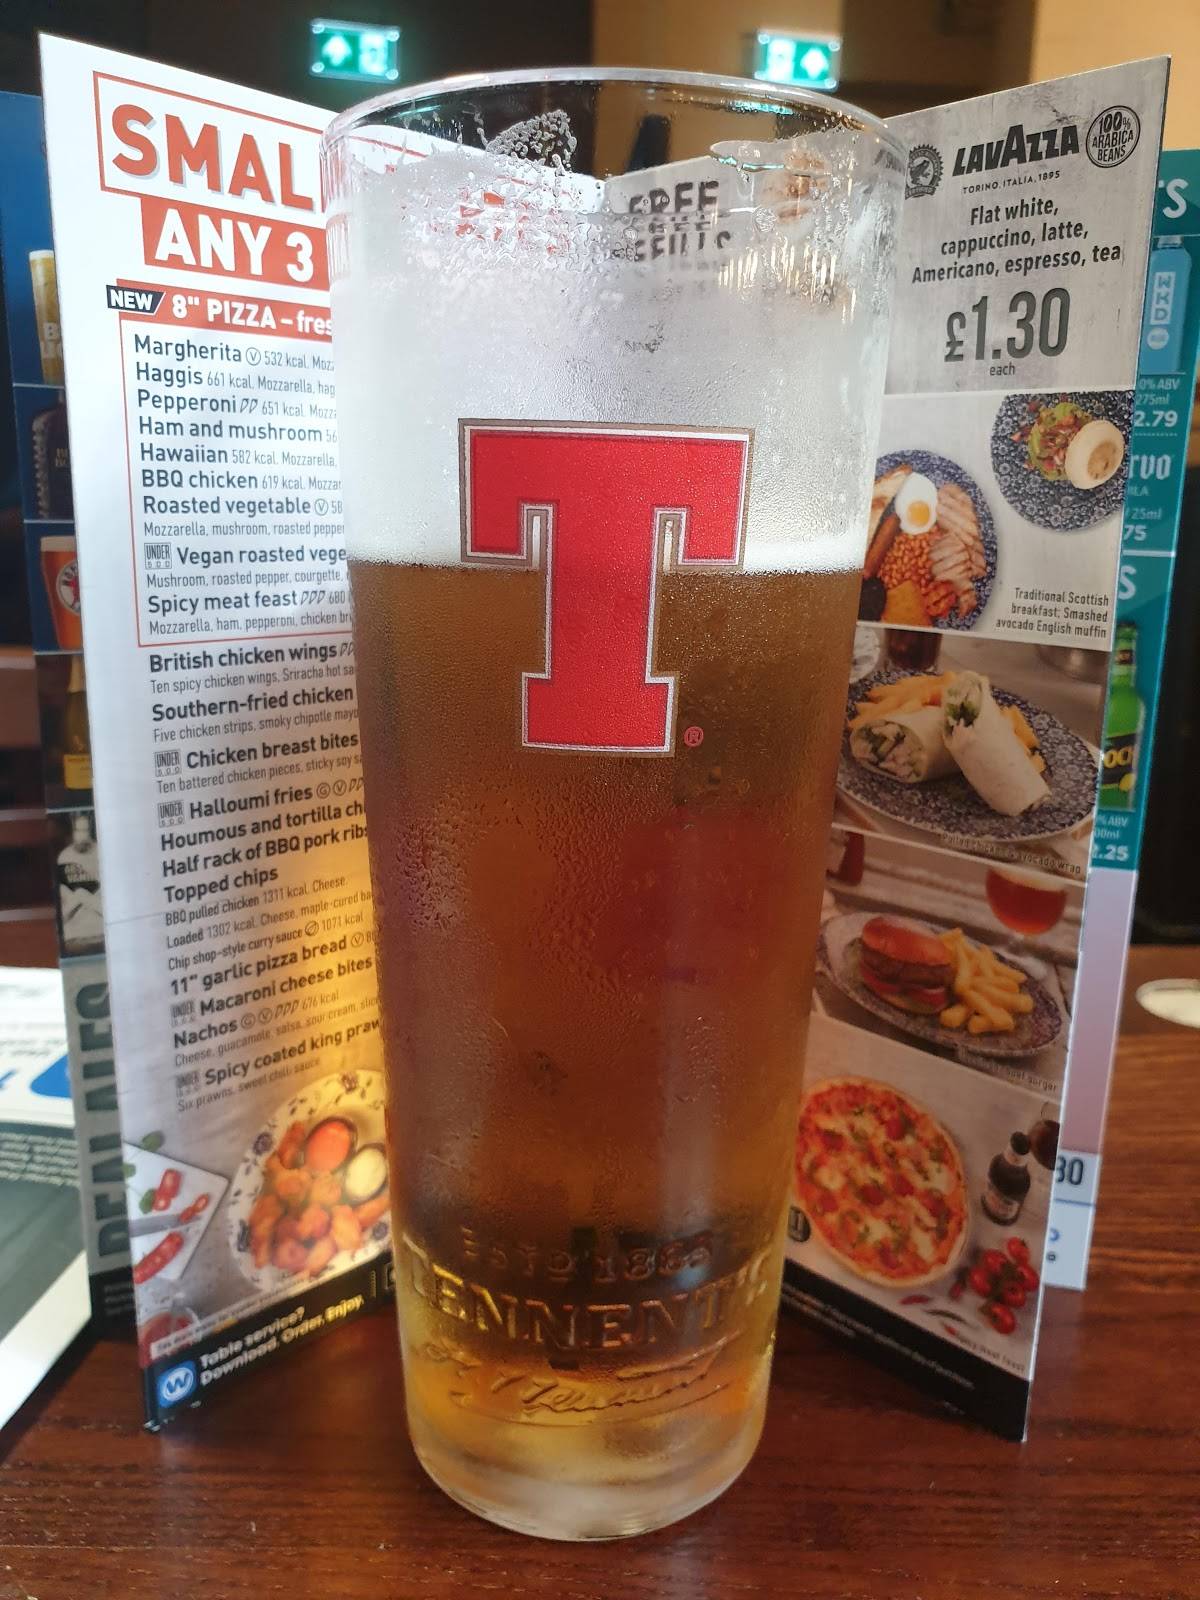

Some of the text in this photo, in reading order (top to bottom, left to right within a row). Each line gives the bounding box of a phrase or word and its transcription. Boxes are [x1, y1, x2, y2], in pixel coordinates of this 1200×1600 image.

[1100, 111, 1131, 134] 100%
[952, 124, 1080, 177] LAVAZZA
[1091, 129, 1134, 149] ARABICA
[112, 104, 325, 212] SMAL
[1097, 145, 1127, 163] BEANS
[1038, 170, 1060, 181] 1895
[970, 198, 1059, 226] Flat white,
[155, 208, 313, 282] ANY 3
[941, 220, 1088, 258] cappuccino, latte,
[912, 244, 1121, 284] Americano, espresso, tea
[111, 290, 153, 310] NEW
[172, 295, 199, 319] 8"
[207, 298, 276, 329] PIZZA
[944, 287, 1070, 362] £1.30
[135, 334, 282, 363] Margherita 532
[136, 362, 203, 387] Haggis
[207, 372, 224, 387] 661
[989, 362, 1015, 376] each
[138, 389, 236, 414] Pepperoni
[262, 401, 279, 415] 651
[140, 417, 322, 442] Ham and mushroom
[141, 443, 228, 463] Hawaiian
[233, 450, 250, 464] 582
[142, 469, 183, 488] BBQ
[189, 471, 258, 488] chicken
[262, 476, 278, 489] 619
[143, 496, 311, 518] Roasted vegetable
[274, 522, 311, 535] roasted
[177, 546, 347, 568] Vegan roasted vege
[212, 572, 252, 585] roasted
[459, 418, 753, 757] T
[149, 595, 198, 617] Spicy
[205, 593, 250, 610] meat
[255, 591, 297, 607] feast
[1015, 587, 1109, 606] Traditional Scottish
[301, 612, 336, 625] chicken
[996, 619, 1106, 638] avocado English muffin
[1064, 607, 1108, 622] Smashed
[150, 644, 337, 673] British chicken wings
[151, 679, 170, 693] Ten
[173, 677, 202, 694] spicy
[205, 673, 244, 689] chicken
[283, 666, 323, 681] Sriracha
[326, 665, 341, 677] hot
[152, 686, 353, 722] Southern-fried chicken
[154, 728, 176, 743] Five
[179, 722, 221, 740] chicken
[259, 715, 292, 731] smoky
[294, 710, 331, 727] chipotle
[187, 733, 358, 770] Chicken breast bites
[157, 780, 176, 794] Ten
[179, 772, 224, 791] battered
[228, 764, 266, 784] chicken
[306, 759, 334, 773] sticky
[336, 756, 351, 768] soy
[190, 785, 313, 819] Halloumi fries
[161, 806, 342, 851] Houmous and tortilla
[163, 829, 340, 878] Half rack of BBQ pork
[164, 867, 279, 904] Topped chips
[166, 911, 186, 926] BBQ
[189, 903, 220, 923] pulled
[222, 895, 260, 914] chicken
[167, 927, 204, 949] Loaded
[168, 954, 191, 971] Chip
[193, 942, 246, 965] shop-style
[248, 935, 274, 951] curry
[275, 929, 302, 944] sauce
[203, 962, 252, 991] garlic
[256, 950, 299, 976] pizza
[302, 935, 347, 961] bread
[200, 981, 276, 1016] Macaroni
[280, 969, 334, 993] cheese
[338, 955, 373, 976] bites
[174, 1019, 238, 1048] Nachos
[205, 1060, 250, 1085] Spicy
[254, 1042, 306, 1070] coated
[310, 1031, 343, 1050] king
[200, 1338, 243, 1368] Table
[244, 1306, 305, 1347] service?
